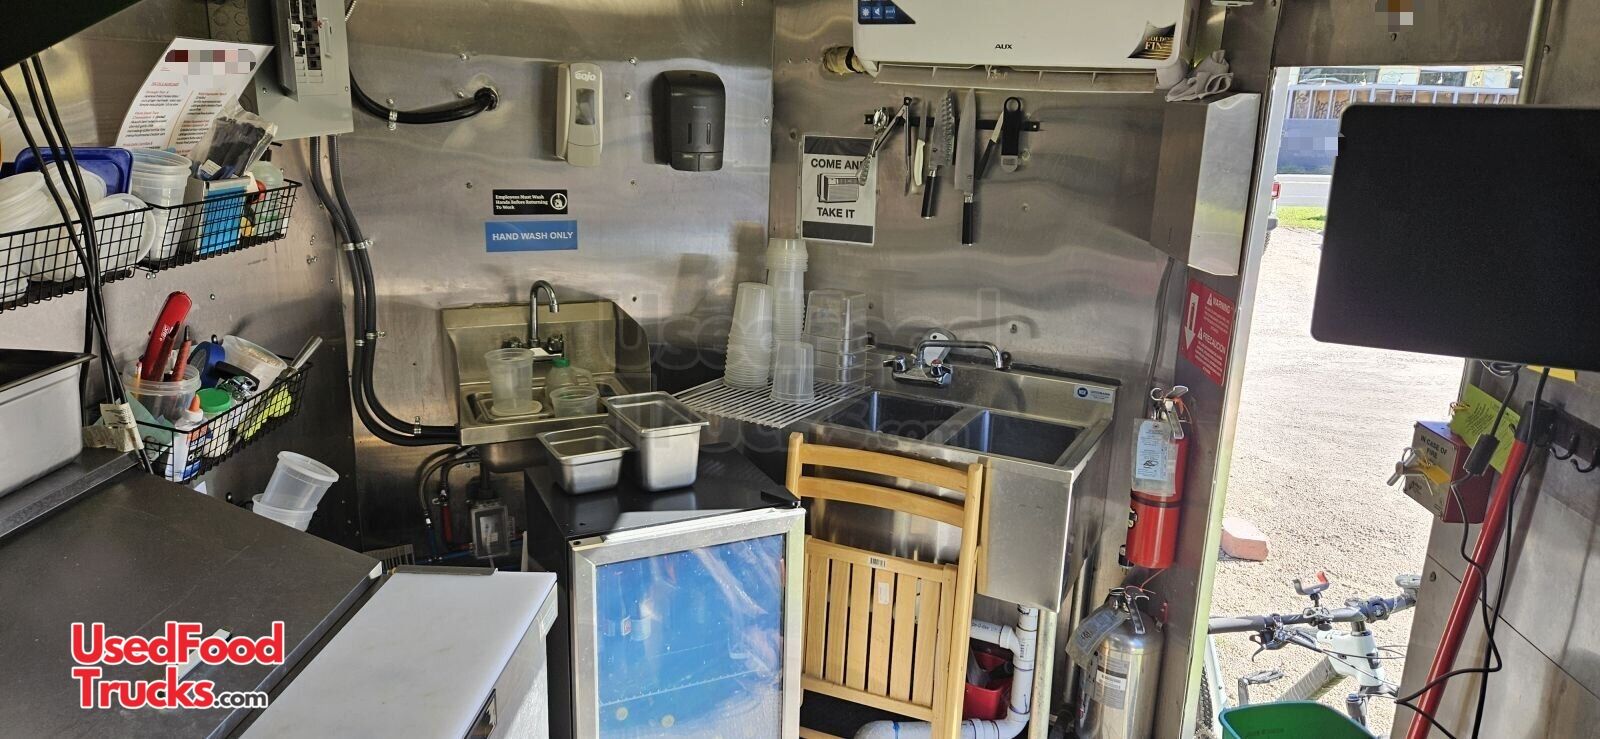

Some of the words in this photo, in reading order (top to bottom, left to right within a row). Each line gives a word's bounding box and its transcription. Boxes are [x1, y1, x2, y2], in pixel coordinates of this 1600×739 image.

[1145, 41, 1163, 50] FIN
[810, 158, 842, 169] COME
[844, 160, 866, 170] AN
[816, 207, 843, 218] TAKE
[845, 209, 856, 218] IT
[492, 232, 519, 241] HAND
[520, 232, 548, 240] WASH
[549, 231, 574, 239] ONLY
[1212, 296, 1231, 314] WARNING
[1420, 435, 1427, 443] IN
[1427, 439, 1440, 451] CASE
[1440, 447, 1448, 456] OF
[1426, 447, 1438, 459] FIRE
